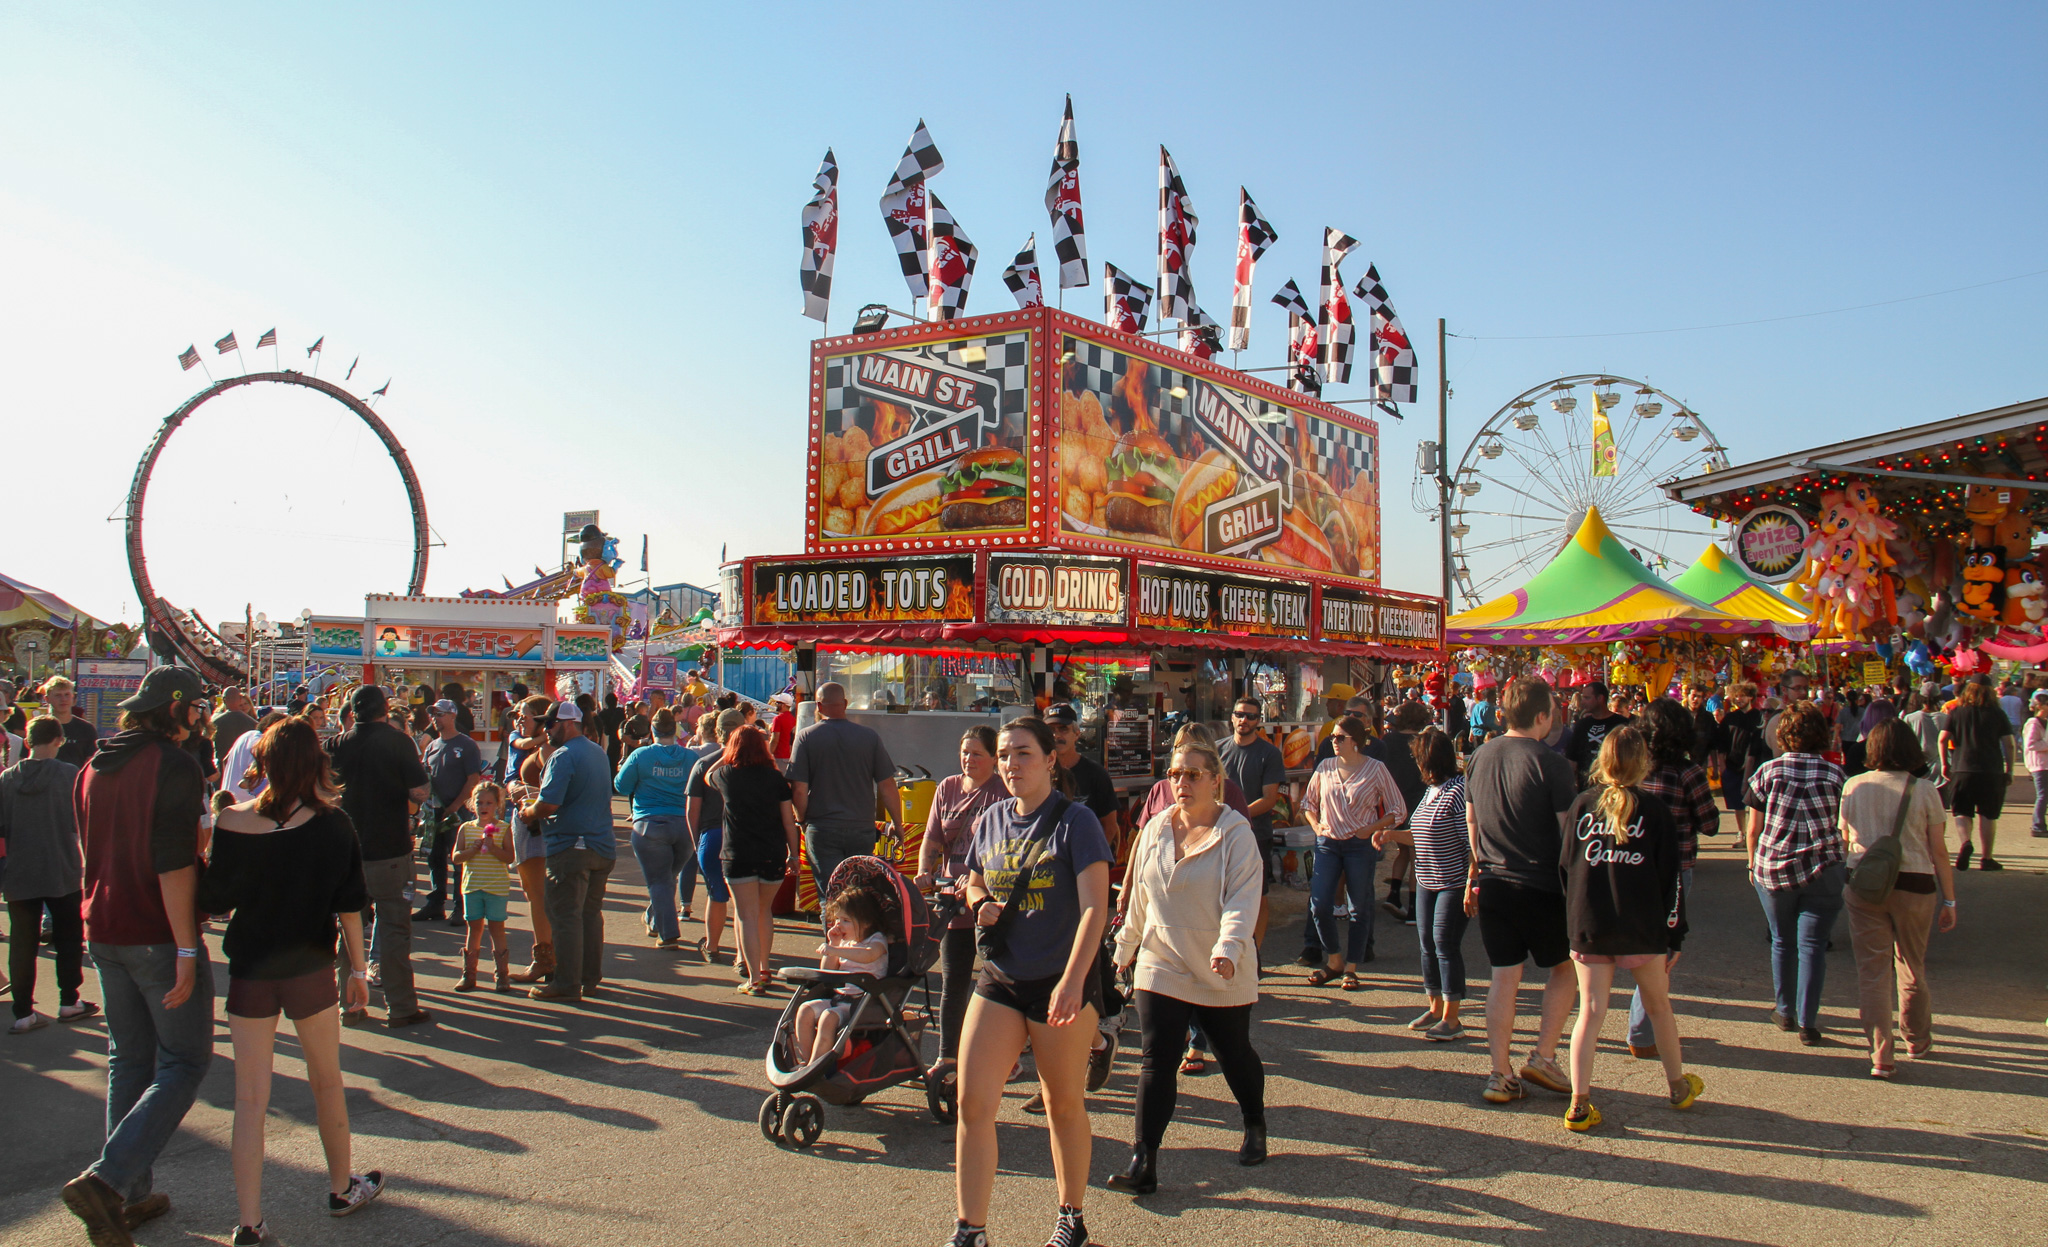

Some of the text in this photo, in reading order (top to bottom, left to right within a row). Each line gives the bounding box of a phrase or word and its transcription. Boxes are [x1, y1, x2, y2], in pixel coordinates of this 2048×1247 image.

[861, 355, 977, 408] MAIN ST.
[1199, 384, 1279, 481] MAIN ST.
[886, 427, 970, 479] GRILL
[1218, 499, 1275, 544] GRILL
[1743, 524, 1800, 550] Prize
[1747, 541, 1802, 563] Every Time
[776, 571, 868, 612] LOADED
[882, 567, 948, 611] TOTS
[1000, 565, 1119, 613] COLD DRINKS
[1140, 576, 1307, 629] HOT DOGS CHEESE STEAK
[1322, 597, 1438, 640] TATER TOTS CHEESEBURGER
[313, 627, 362, 649] TICKETS
[405, 628, 514, 658] TICKETS
[556, 635, 608, 656] TICKETS
[79, 678, 140, 689] SIZE WIZE
[1048, 708, 1061, 716] CAT
[1122, 710, 1139, 719] MENU
[652, 766, 684, 777] FINTECH
[1576, 813, 1645, 840] Calld
[1584, 839, 1645, 867] Game
